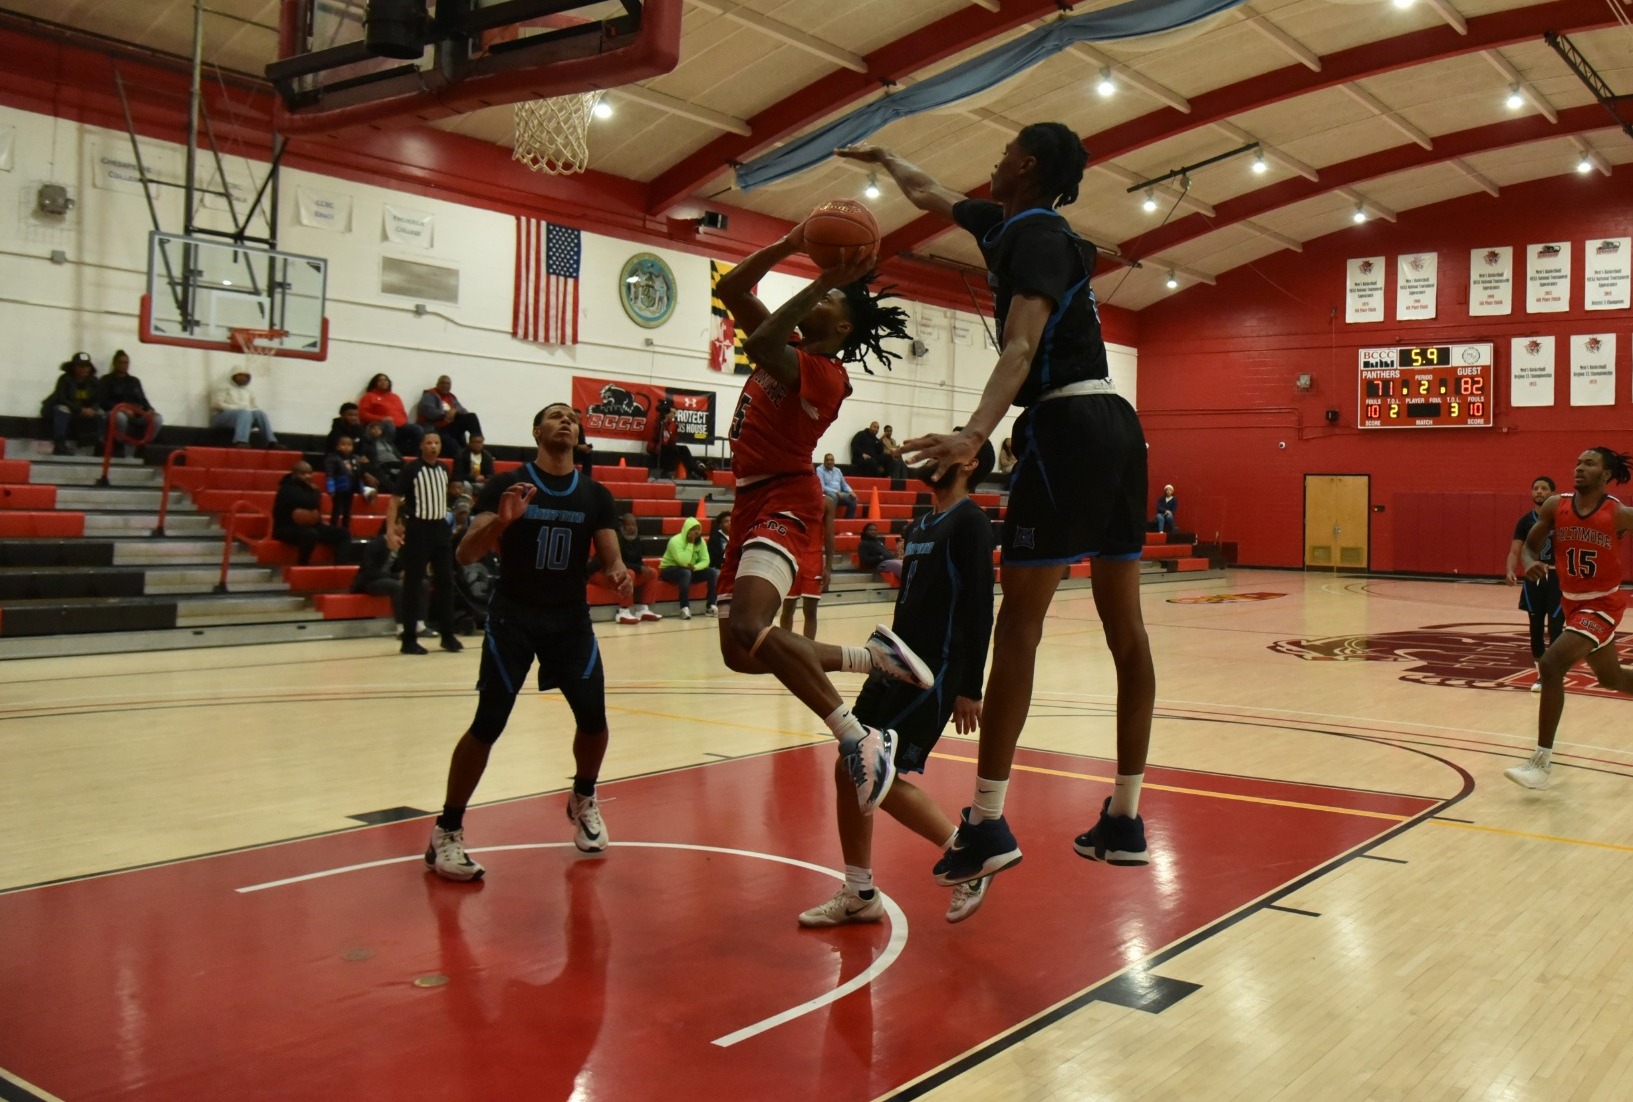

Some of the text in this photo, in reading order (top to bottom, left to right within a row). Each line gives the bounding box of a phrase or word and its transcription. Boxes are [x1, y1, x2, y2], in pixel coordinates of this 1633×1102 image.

[1363, 351, 1395, 359] BCCC
[1411, 348, 1437, 366] 5.9
[1362, 370, 1400, 379] PANTHERS
[1457, 367, 1481, 376] GUEST
[1373, 380, 1393, 396] 71
[1420, 381, 1429, 394] 2
[1461, 377, 1483, 394] 82
[677, 410, 708, 423] ROTECT
[1368, 402, 1482, 418] 10 2 3 10
[535, 526, 572, 570] 10
[1566, 547, 1597, 579] 15
